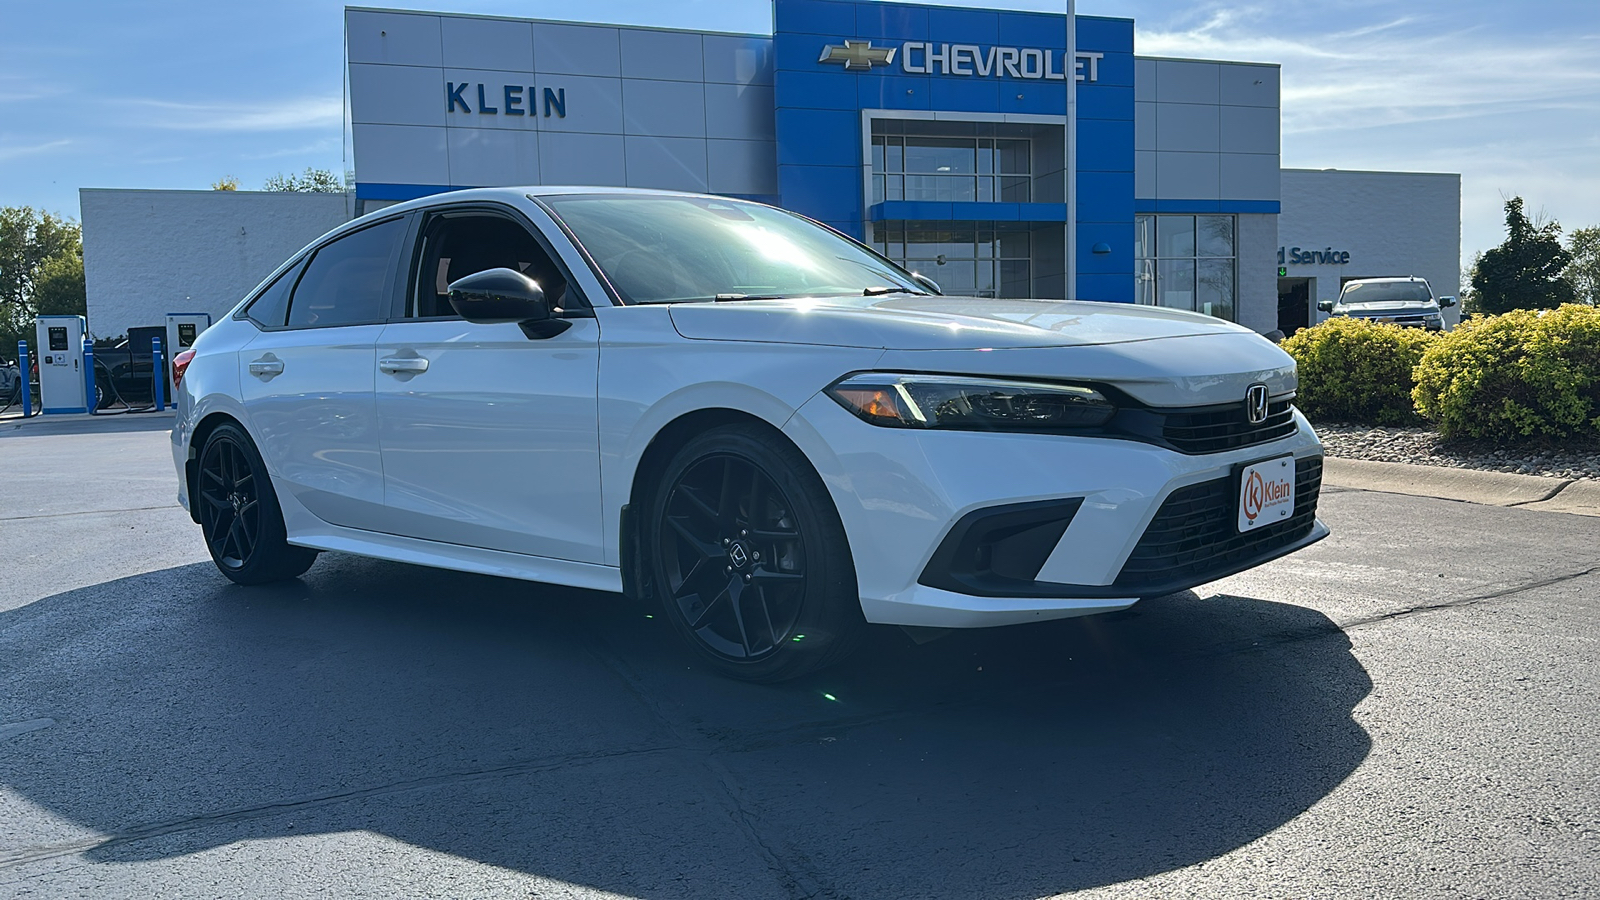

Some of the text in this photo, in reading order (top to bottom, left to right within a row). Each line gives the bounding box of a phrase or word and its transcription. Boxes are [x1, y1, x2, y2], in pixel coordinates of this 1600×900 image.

[902, 41, 1104, 82] CHEVROLET
[446, 81, 567, 119] KLEIN
[1289, 246, 1350, 265] Service
[1265, 478, 1290, 502] Klein
